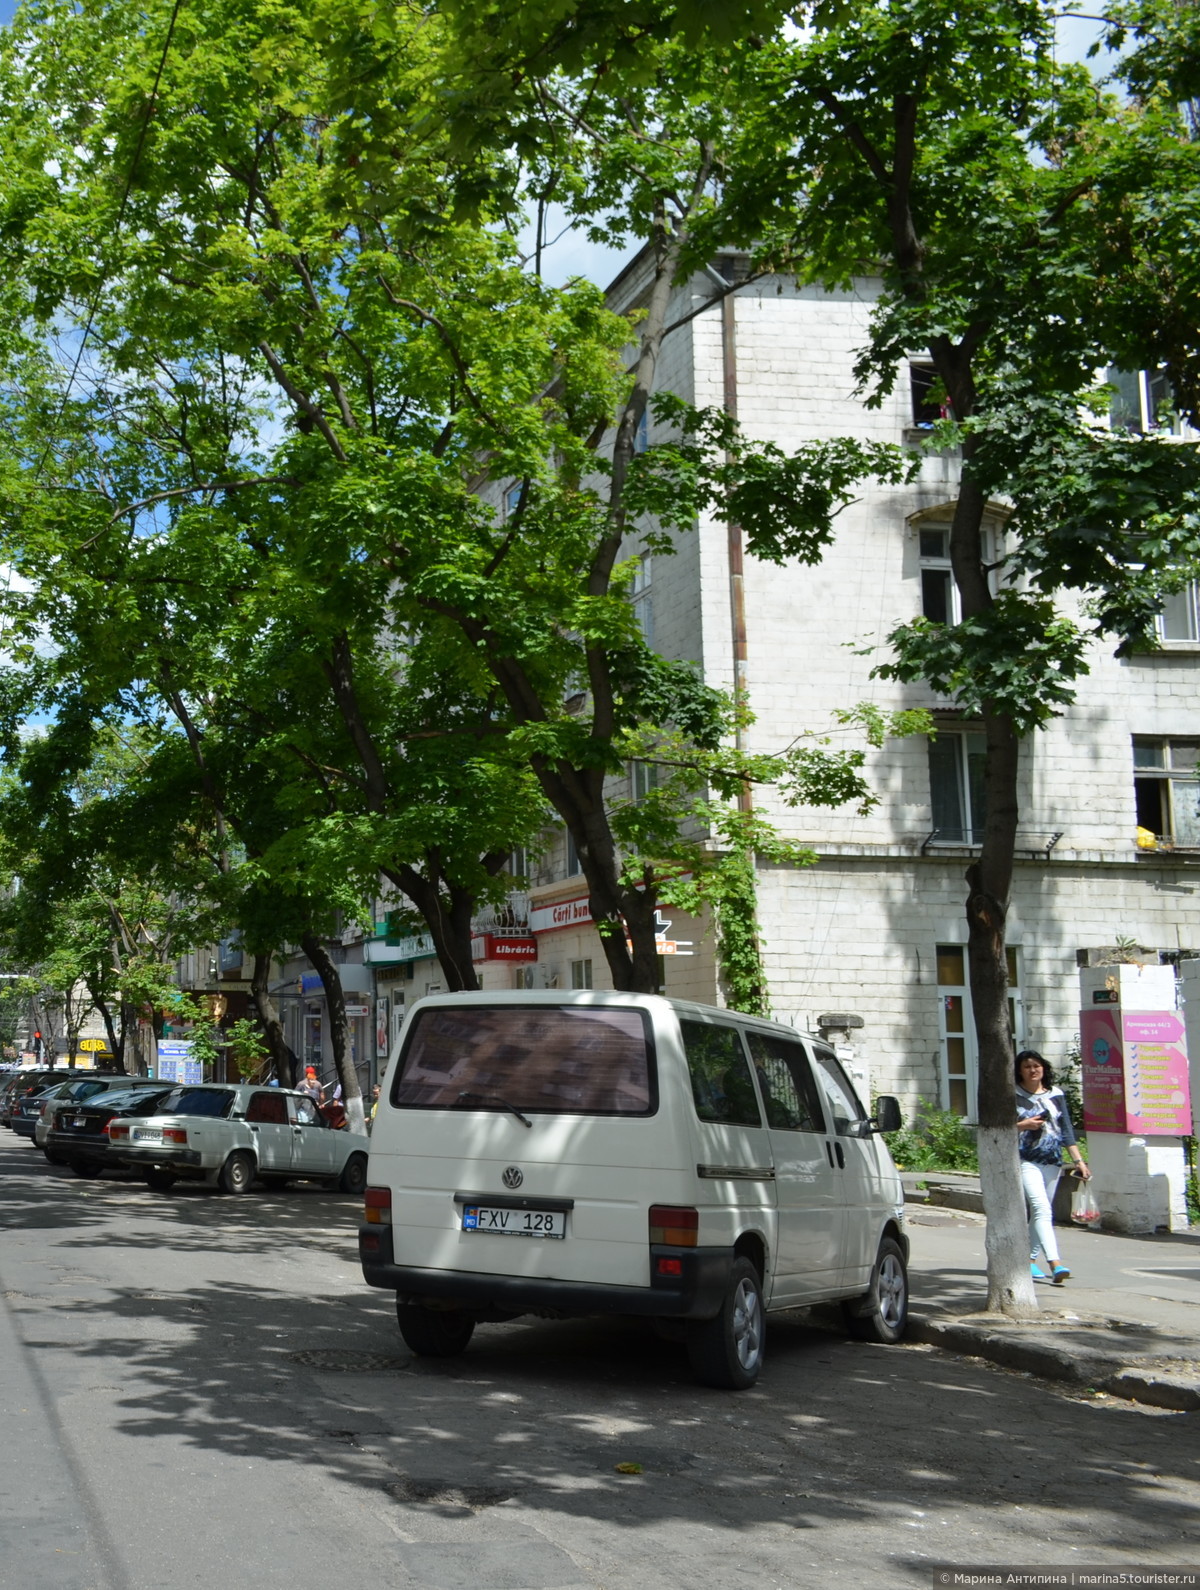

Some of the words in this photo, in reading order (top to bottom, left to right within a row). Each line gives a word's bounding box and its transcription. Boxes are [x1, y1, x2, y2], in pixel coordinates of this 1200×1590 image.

[574, 906, 590, 920] bun
[496, 945, 536, 954] Librărie
[478, 1210, 509, 1228] FXV
[523, 1213, 553, 1231] 128
